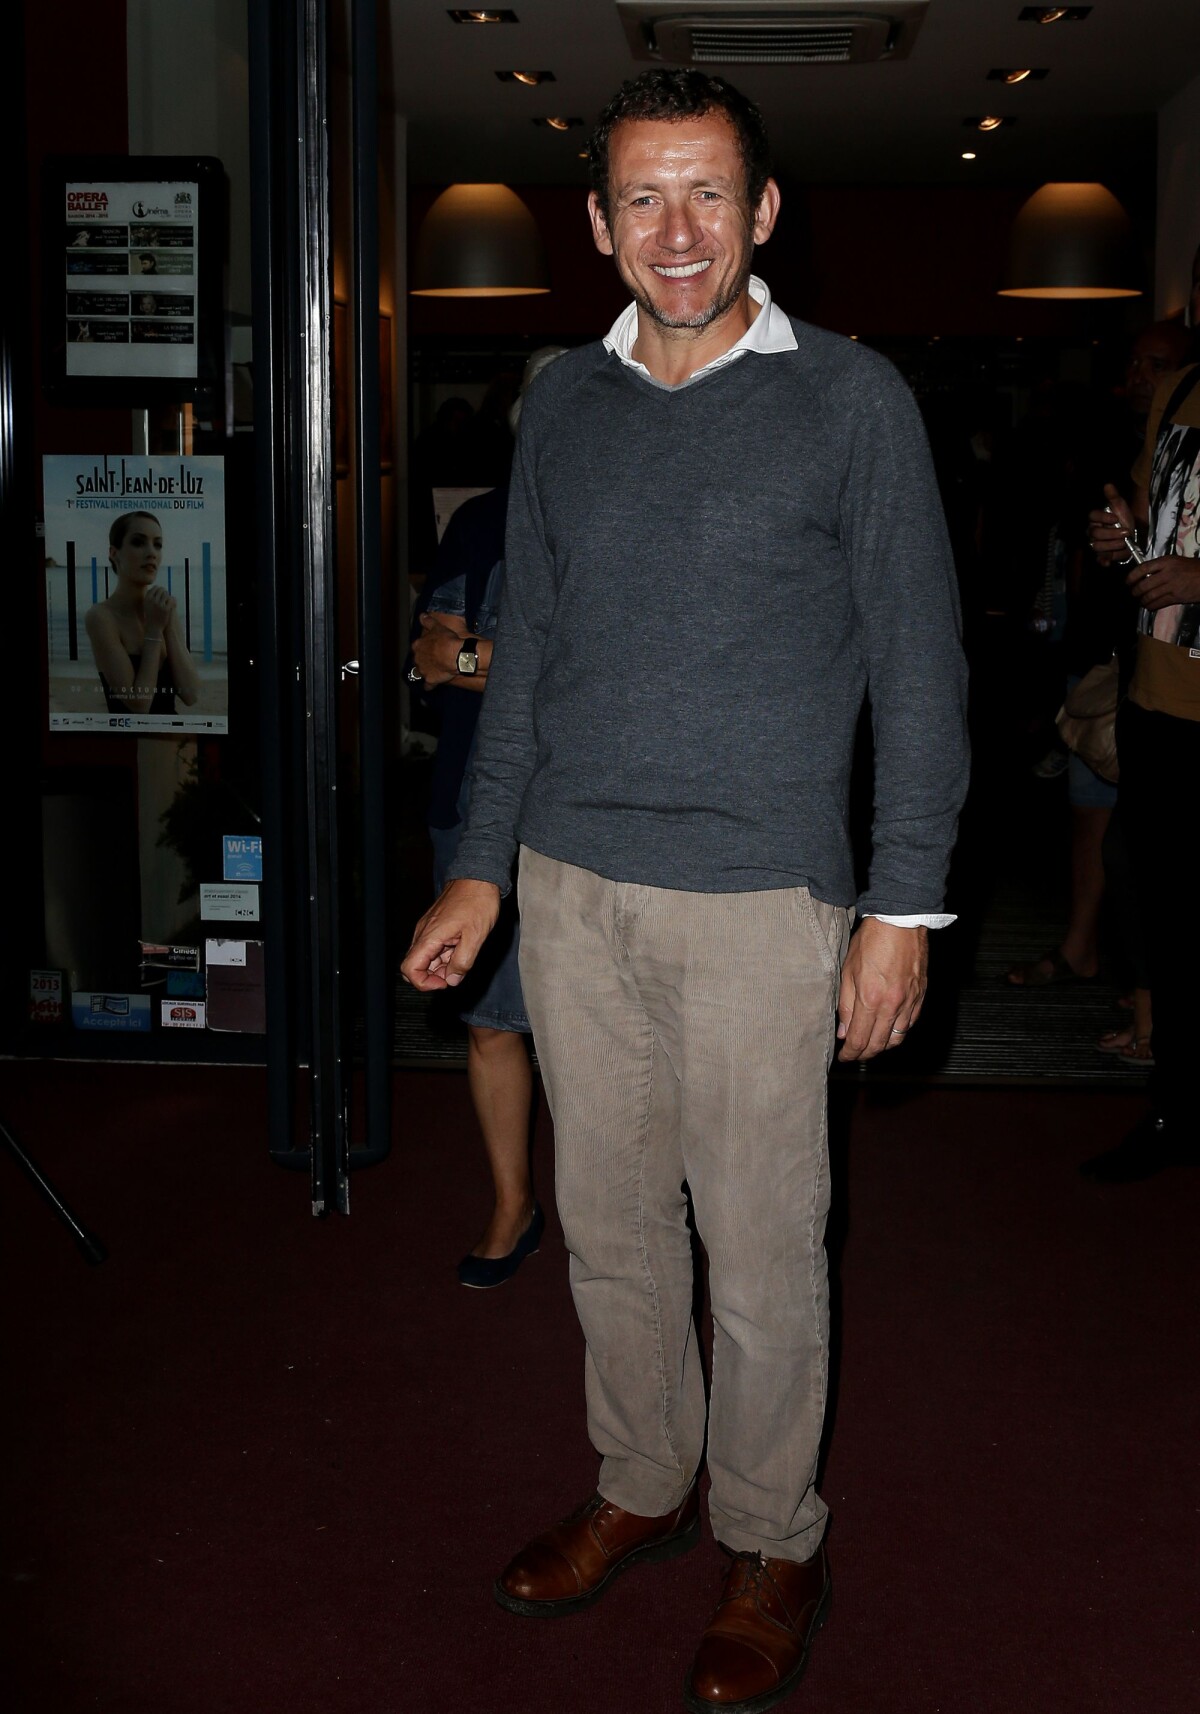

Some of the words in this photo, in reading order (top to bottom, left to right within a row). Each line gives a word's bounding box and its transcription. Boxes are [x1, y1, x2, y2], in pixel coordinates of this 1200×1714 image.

[68, 192, 108, 202] OPERA
[68, 202, 109, 211] BALLET
[76, 500, 109, 509] FESTIVAL
[110, 500, 172, 509] INTERNATIONAL
[174, 500, 185, 509] DU
[187, 500, 204, 509] FILM
[227, 840, 262, 853] Wi-Fi
[33, 978, 60, 990] 2013
[174, 1008, 194, 1018] SIS
